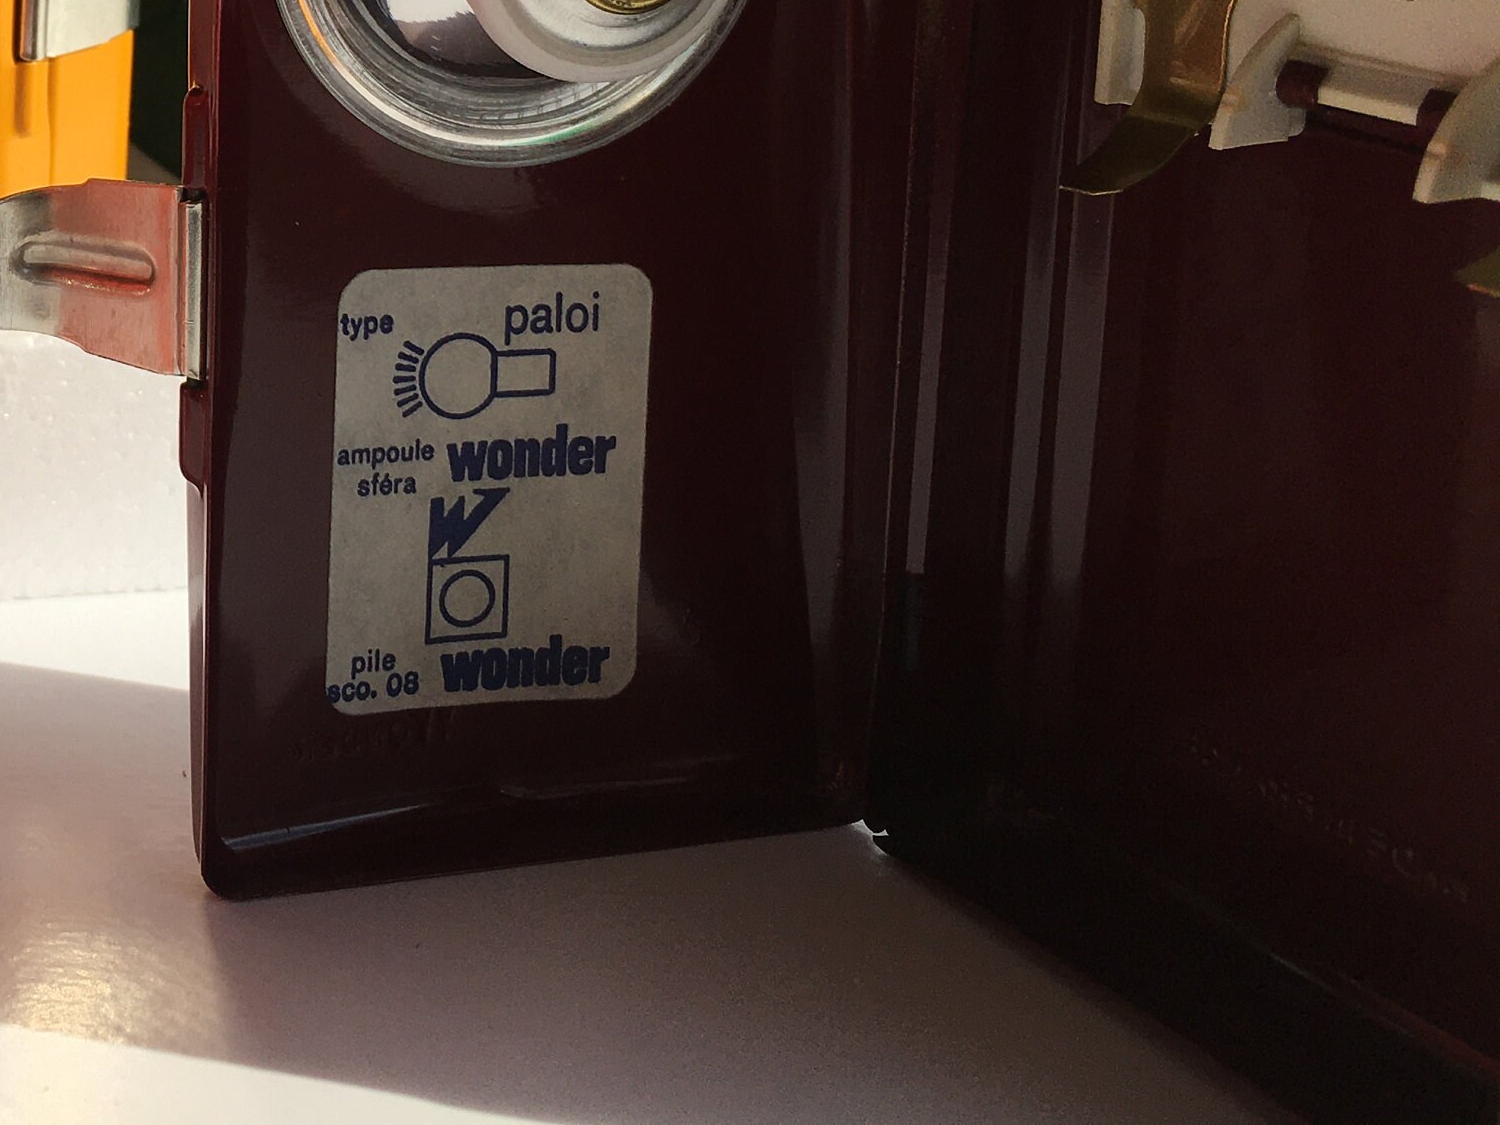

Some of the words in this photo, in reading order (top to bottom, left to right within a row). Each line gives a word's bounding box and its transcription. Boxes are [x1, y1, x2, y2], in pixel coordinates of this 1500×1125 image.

[339, 313, 394, 342] type
[503, 290, 601, 347] paloi
[336, 437, 435, 471] ampoule
[446, 421, 617, 483] wonder
[356, 471, 417, 497] sféra
[326, 680, 378, 705] sco.
[385, 670, 420, 699] 08
[350, 648, 397, 681] pile
[439, 633, 611, 693] wonder
